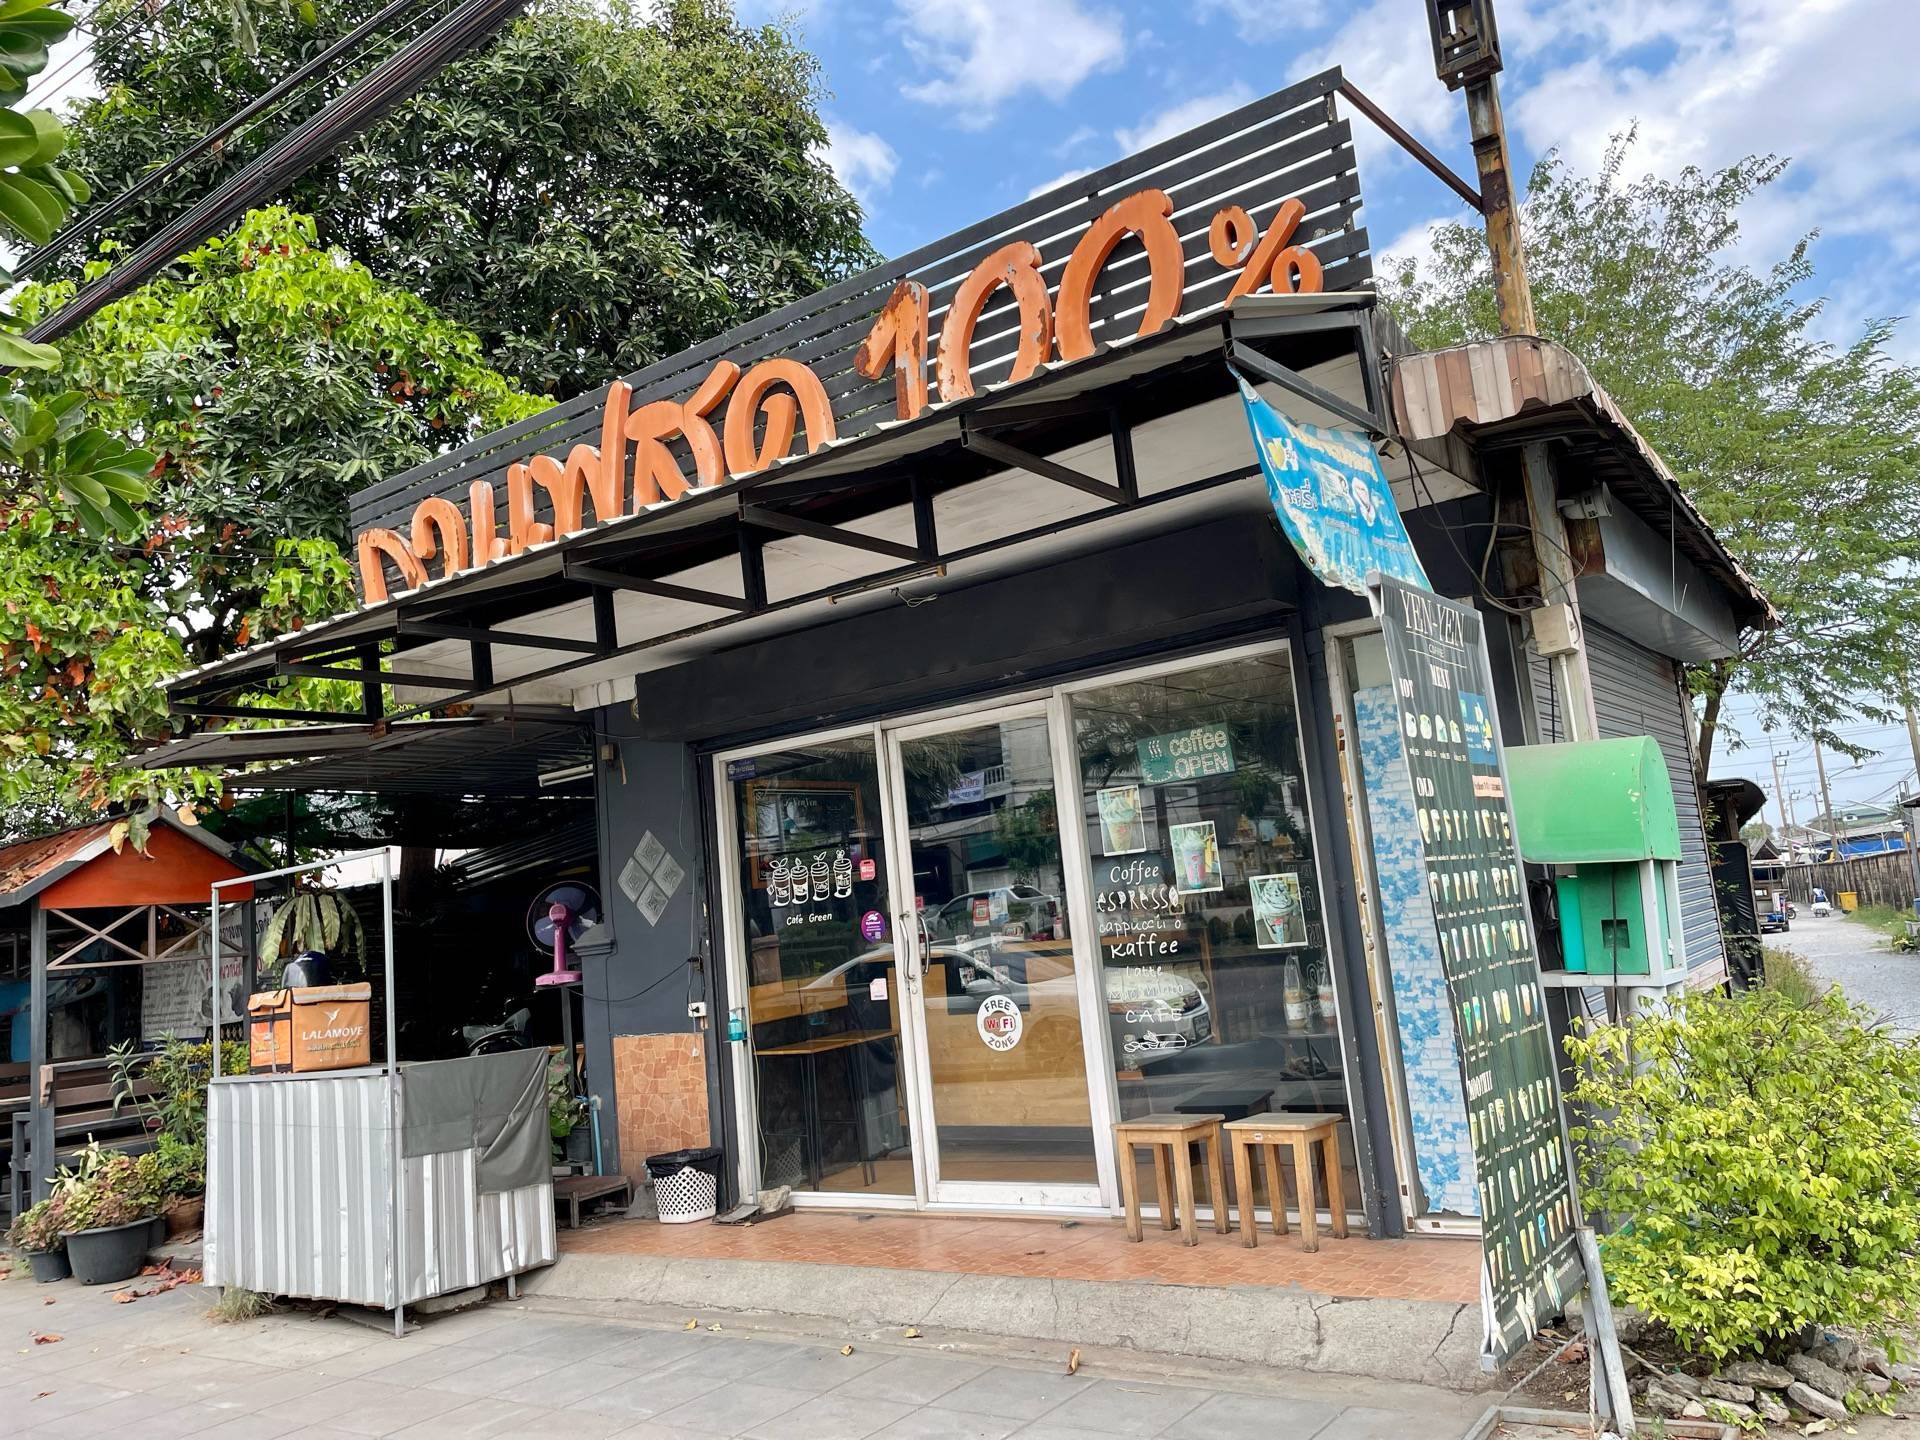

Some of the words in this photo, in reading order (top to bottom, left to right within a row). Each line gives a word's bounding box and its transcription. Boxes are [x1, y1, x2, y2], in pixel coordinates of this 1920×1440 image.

[357, 358, 837, 603] กาแฟสด
[854, 188, 1324, 421] 100%
[1400, 589, 1465, 647] YEN-YEN
[1169, 728, 1228, 756] coffee
[1175, 751, 1230, 779] OPEN
[1110, 860, 1160, 885] Coffee
[809, 912, 833, 924] Green
[983, 999, 1011, 1012] FREE
[302, 1025, 365, 1041] LALAMOVE
[987, 1035, 1015, 1049] ZONE
